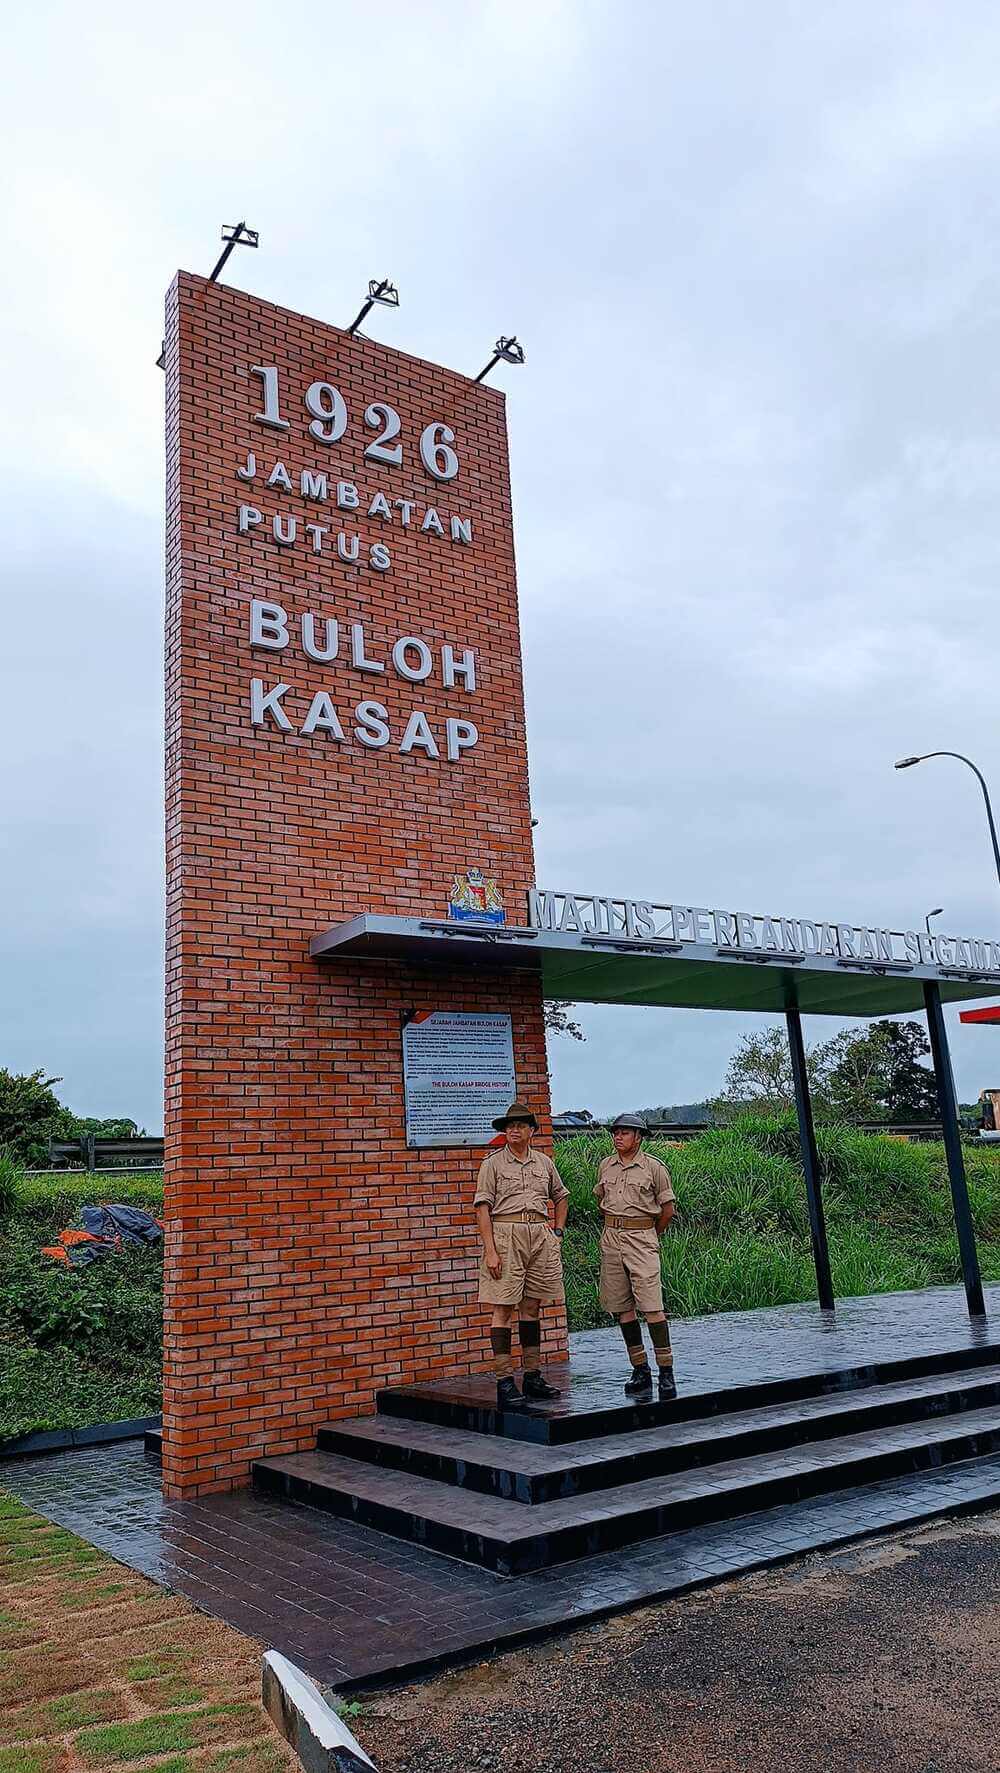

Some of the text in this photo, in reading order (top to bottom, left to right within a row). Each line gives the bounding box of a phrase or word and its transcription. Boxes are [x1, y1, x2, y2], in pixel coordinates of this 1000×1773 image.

[251, 365, 459, 482] 1926
[237, 452, 472, 545] JAMBATAN
[238, 504, 391, 571] PUTUS
[250, 598, 477, 694] BULOH
[250, 677, 479, 762] KASAP
[529, 889, 656, 939] MAJLIS
[671, 904, 894, 961] PERBANDARAN
[452, 1019, 476, 1027] JAMBATAN
